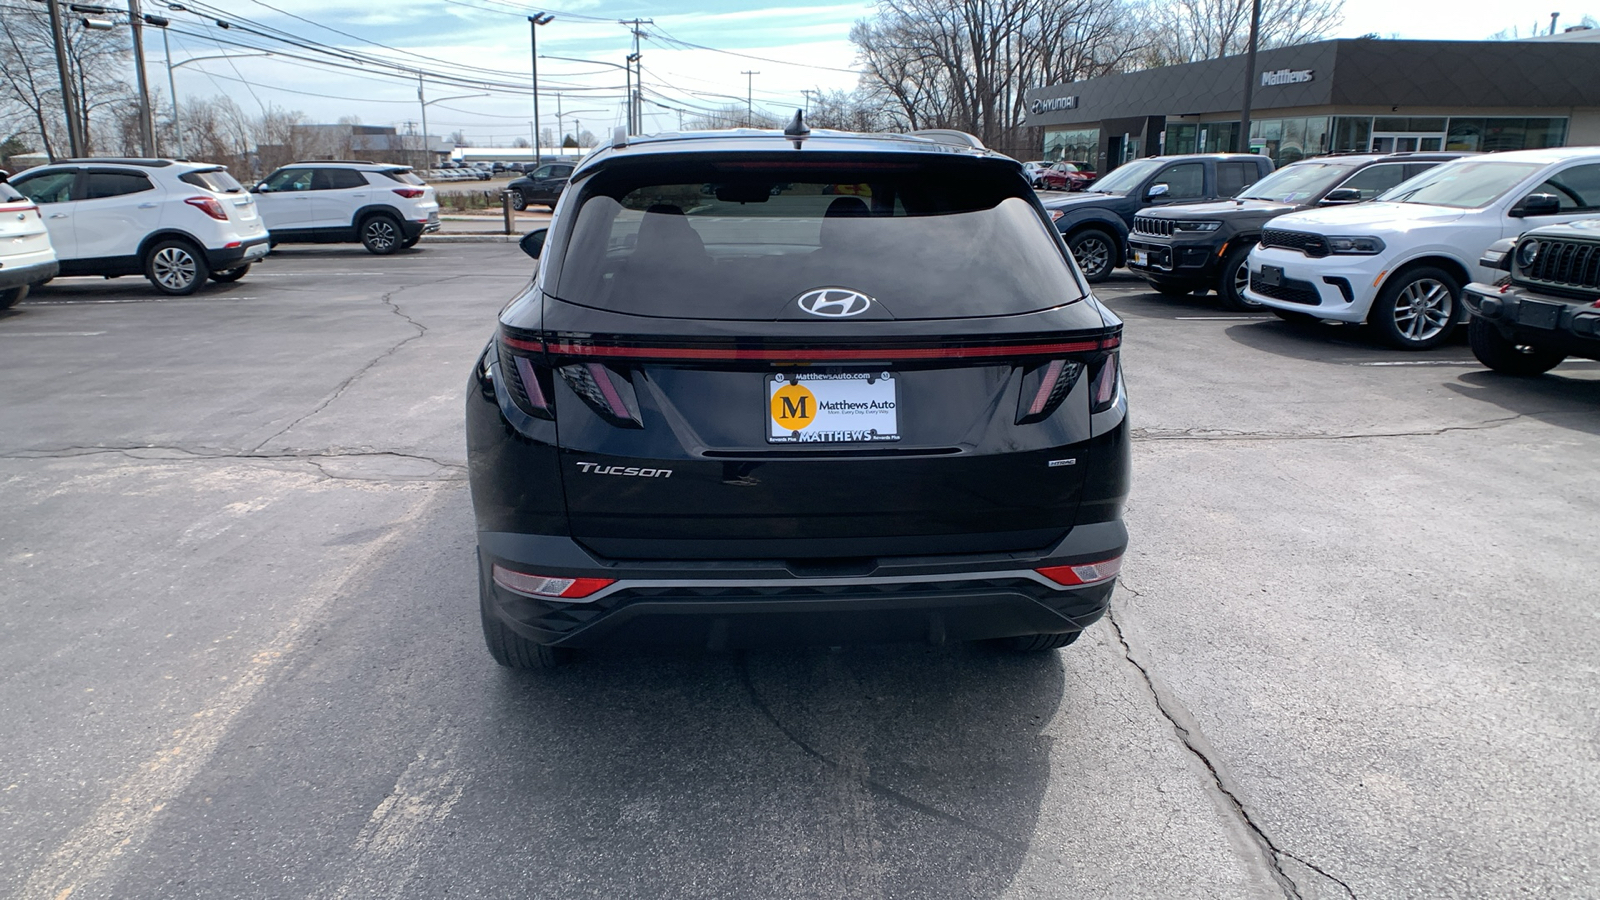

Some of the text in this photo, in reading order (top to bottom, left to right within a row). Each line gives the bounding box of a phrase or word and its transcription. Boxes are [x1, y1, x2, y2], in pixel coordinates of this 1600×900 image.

[1262, 69, 1312, 86] Matthews
[1043, 96, 1075, 111] HYUNDAI
[779, 396, 809, 418] M
[819, 400, 896, 410] Matthews Auto
[799, 430, 872, 442] MATTHEWS
